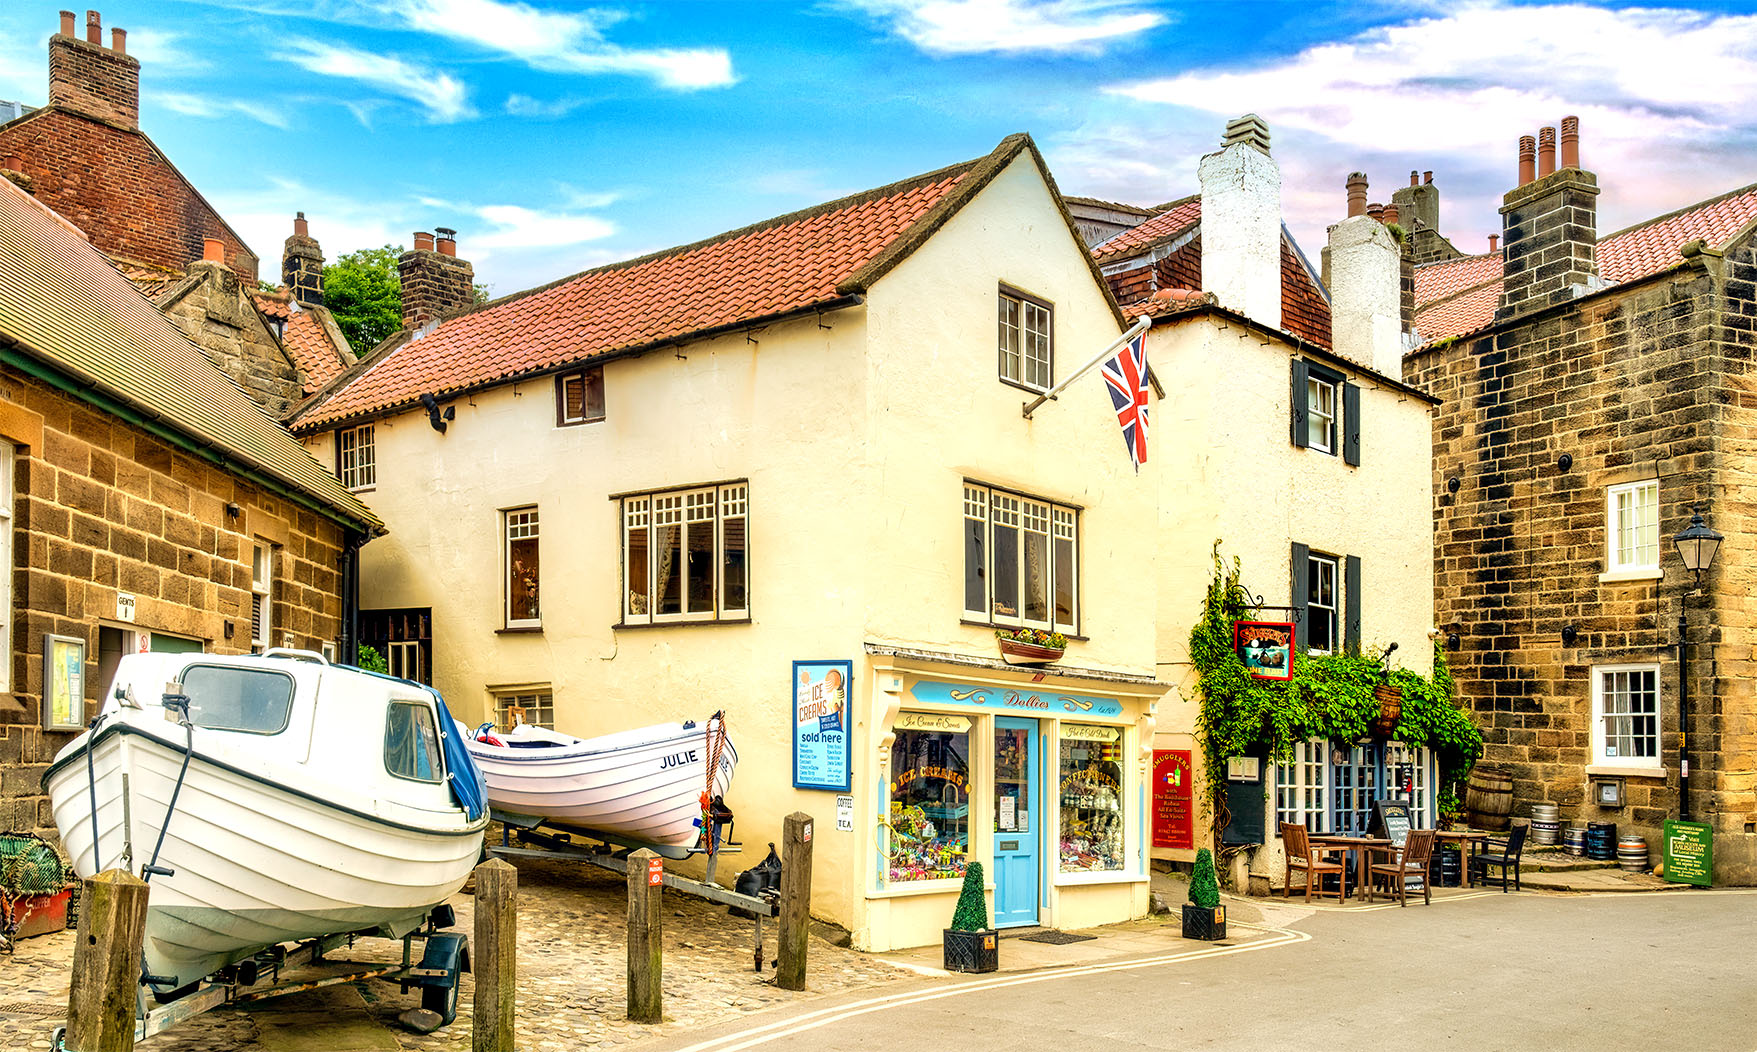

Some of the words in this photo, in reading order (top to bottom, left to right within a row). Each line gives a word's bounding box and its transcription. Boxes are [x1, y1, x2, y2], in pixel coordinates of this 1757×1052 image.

[118, 596, 135, 608] GENTS
[812, 683, 823, 701] ICE
[1003, 690, 1049, 710] Dollies
[799, 700, 827, 722] CREAMS
[902, 714, 915, 727] Ice
[801, 732, 820, 743] sold
[821, 732, 842, 744] here
[660, 750, 698, 769] JULIE
[1152, 753, 1190, 770] SMUGGLERS
[898, 768, 916, 786] ICE
[920, 766, 963, 786] CREAMS
[837, 797, 852, 808] COFFEE
[838, 819, 851, 829] TEA
[1674, 844, 1705, 853] MUSEUM
